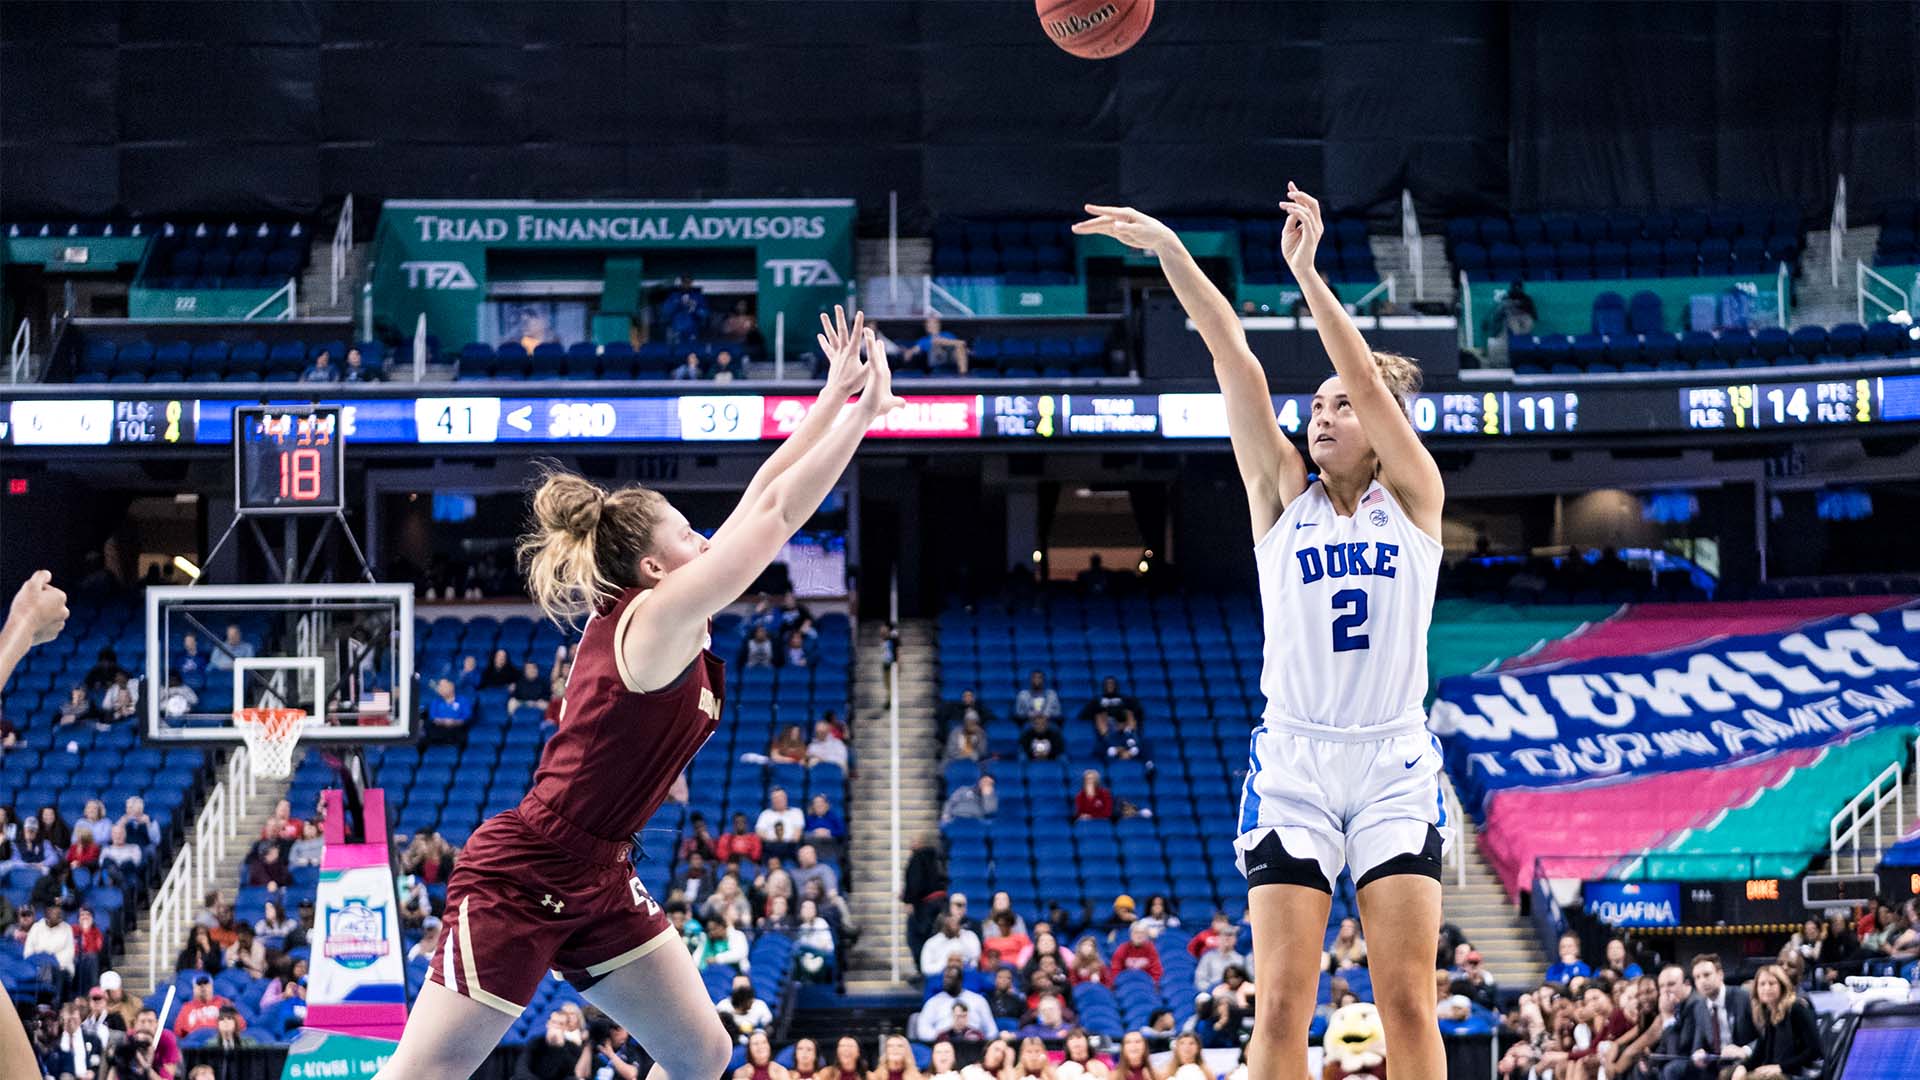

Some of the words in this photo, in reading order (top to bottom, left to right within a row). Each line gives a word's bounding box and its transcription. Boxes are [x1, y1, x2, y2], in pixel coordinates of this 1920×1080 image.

[1050, 3, 1118, 39] Wilson
[400, 261, 478, 289] TFA
[764, 259, 843, 287] TFA
[117, 402, 154, 420] FLS:
[436, 406, 473, 434] 41
[549, 403, 617, 438] 3RD
[700, 403, 740, 433] 39
[1518, 396, 1556, 432] 11
[1767, 387, 1810, 423] 14
[118, 422, 155, 441] TOL:
[280, 449, 321, 499] 18
[1296, 542, 1399, 584] DUKE
[1331, 588, 1370, 652] 2
[1745, 879, 1780, 900] DUKE
